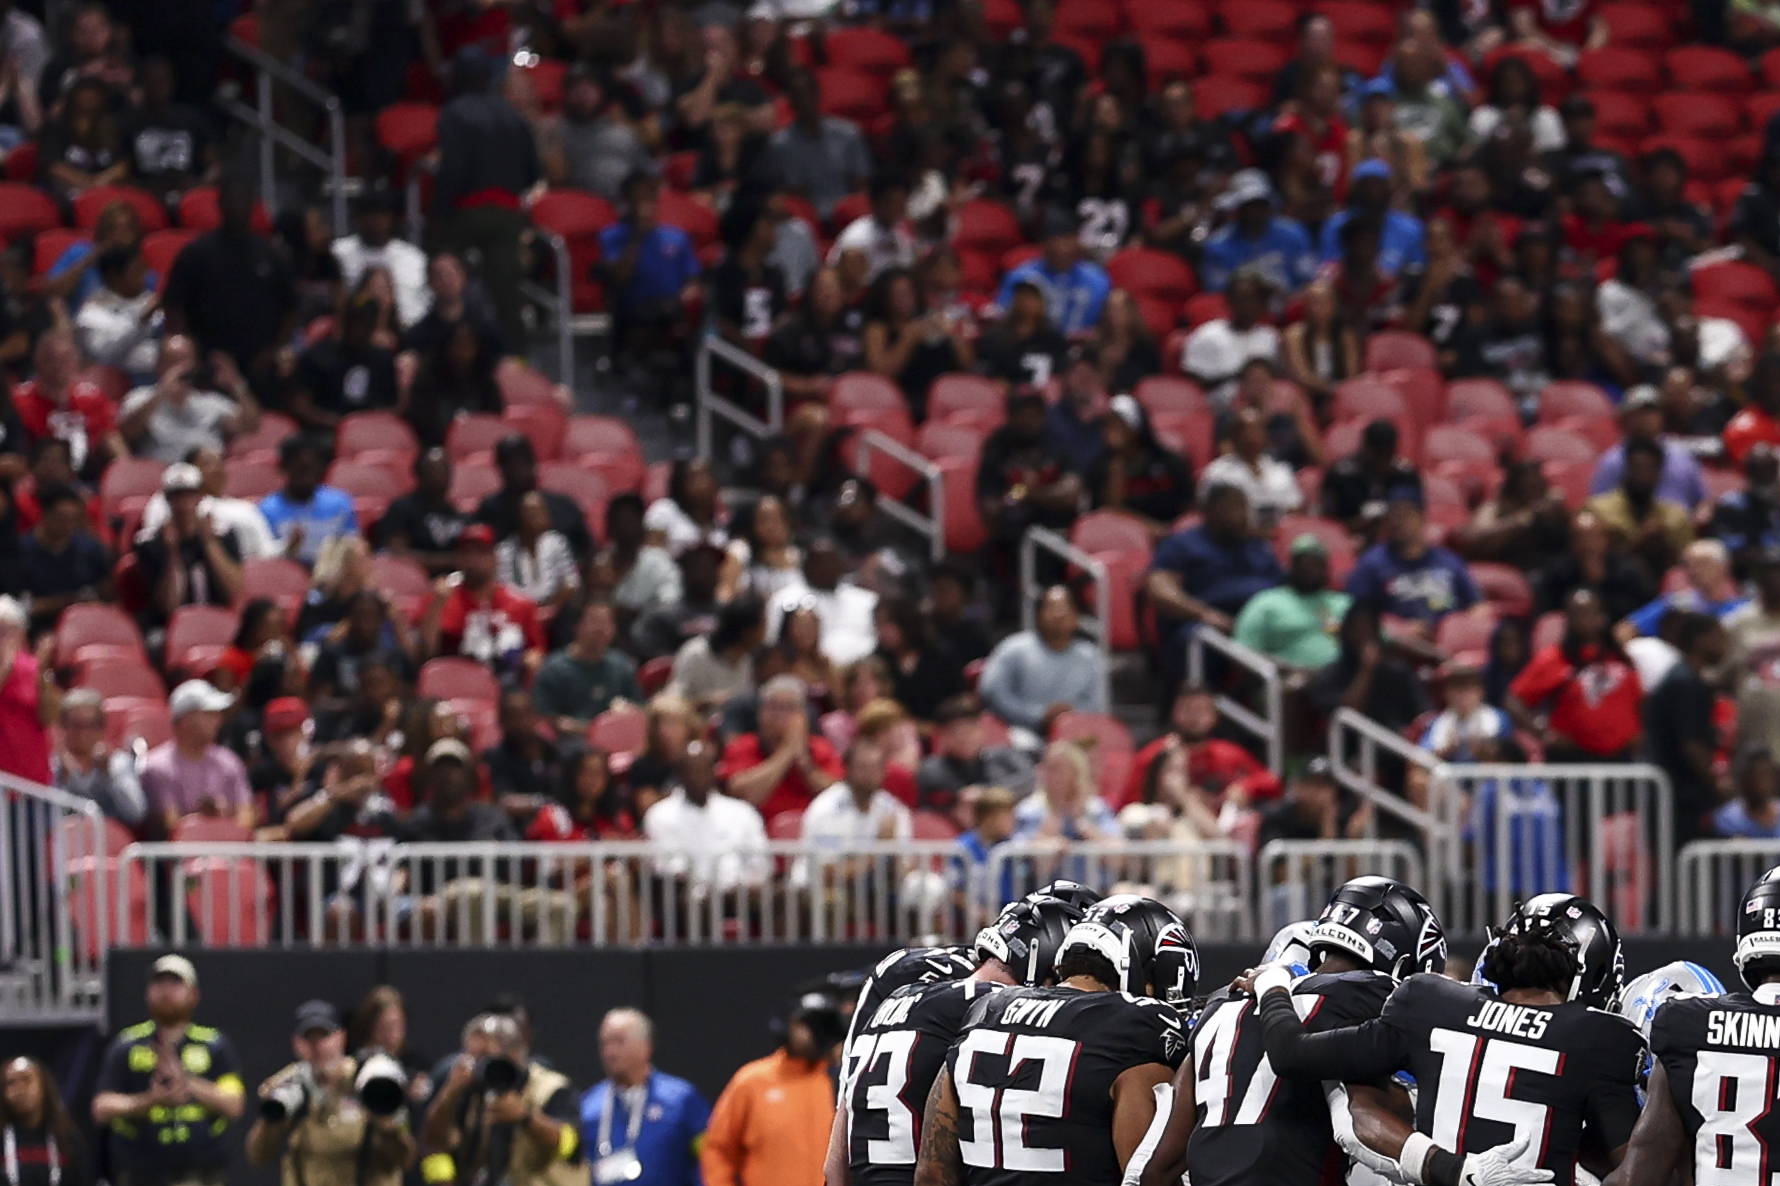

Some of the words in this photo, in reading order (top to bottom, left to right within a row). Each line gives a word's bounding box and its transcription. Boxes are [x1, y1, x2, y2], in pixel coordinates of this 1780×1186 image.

[1081, 907, 1109, 923] 52
[1330, 904, 1360, 926] 47
[1000, 998, 1065, 1027] GWYN
[1466, 1001, 1553, 1040] JONES
[847, 1030, 921, 1165] 73
[954, 1028, 1083, 1173] 52
[1195, 993, 1326, 1128] 47
[1430, 1028, 1567, 1168] 15
